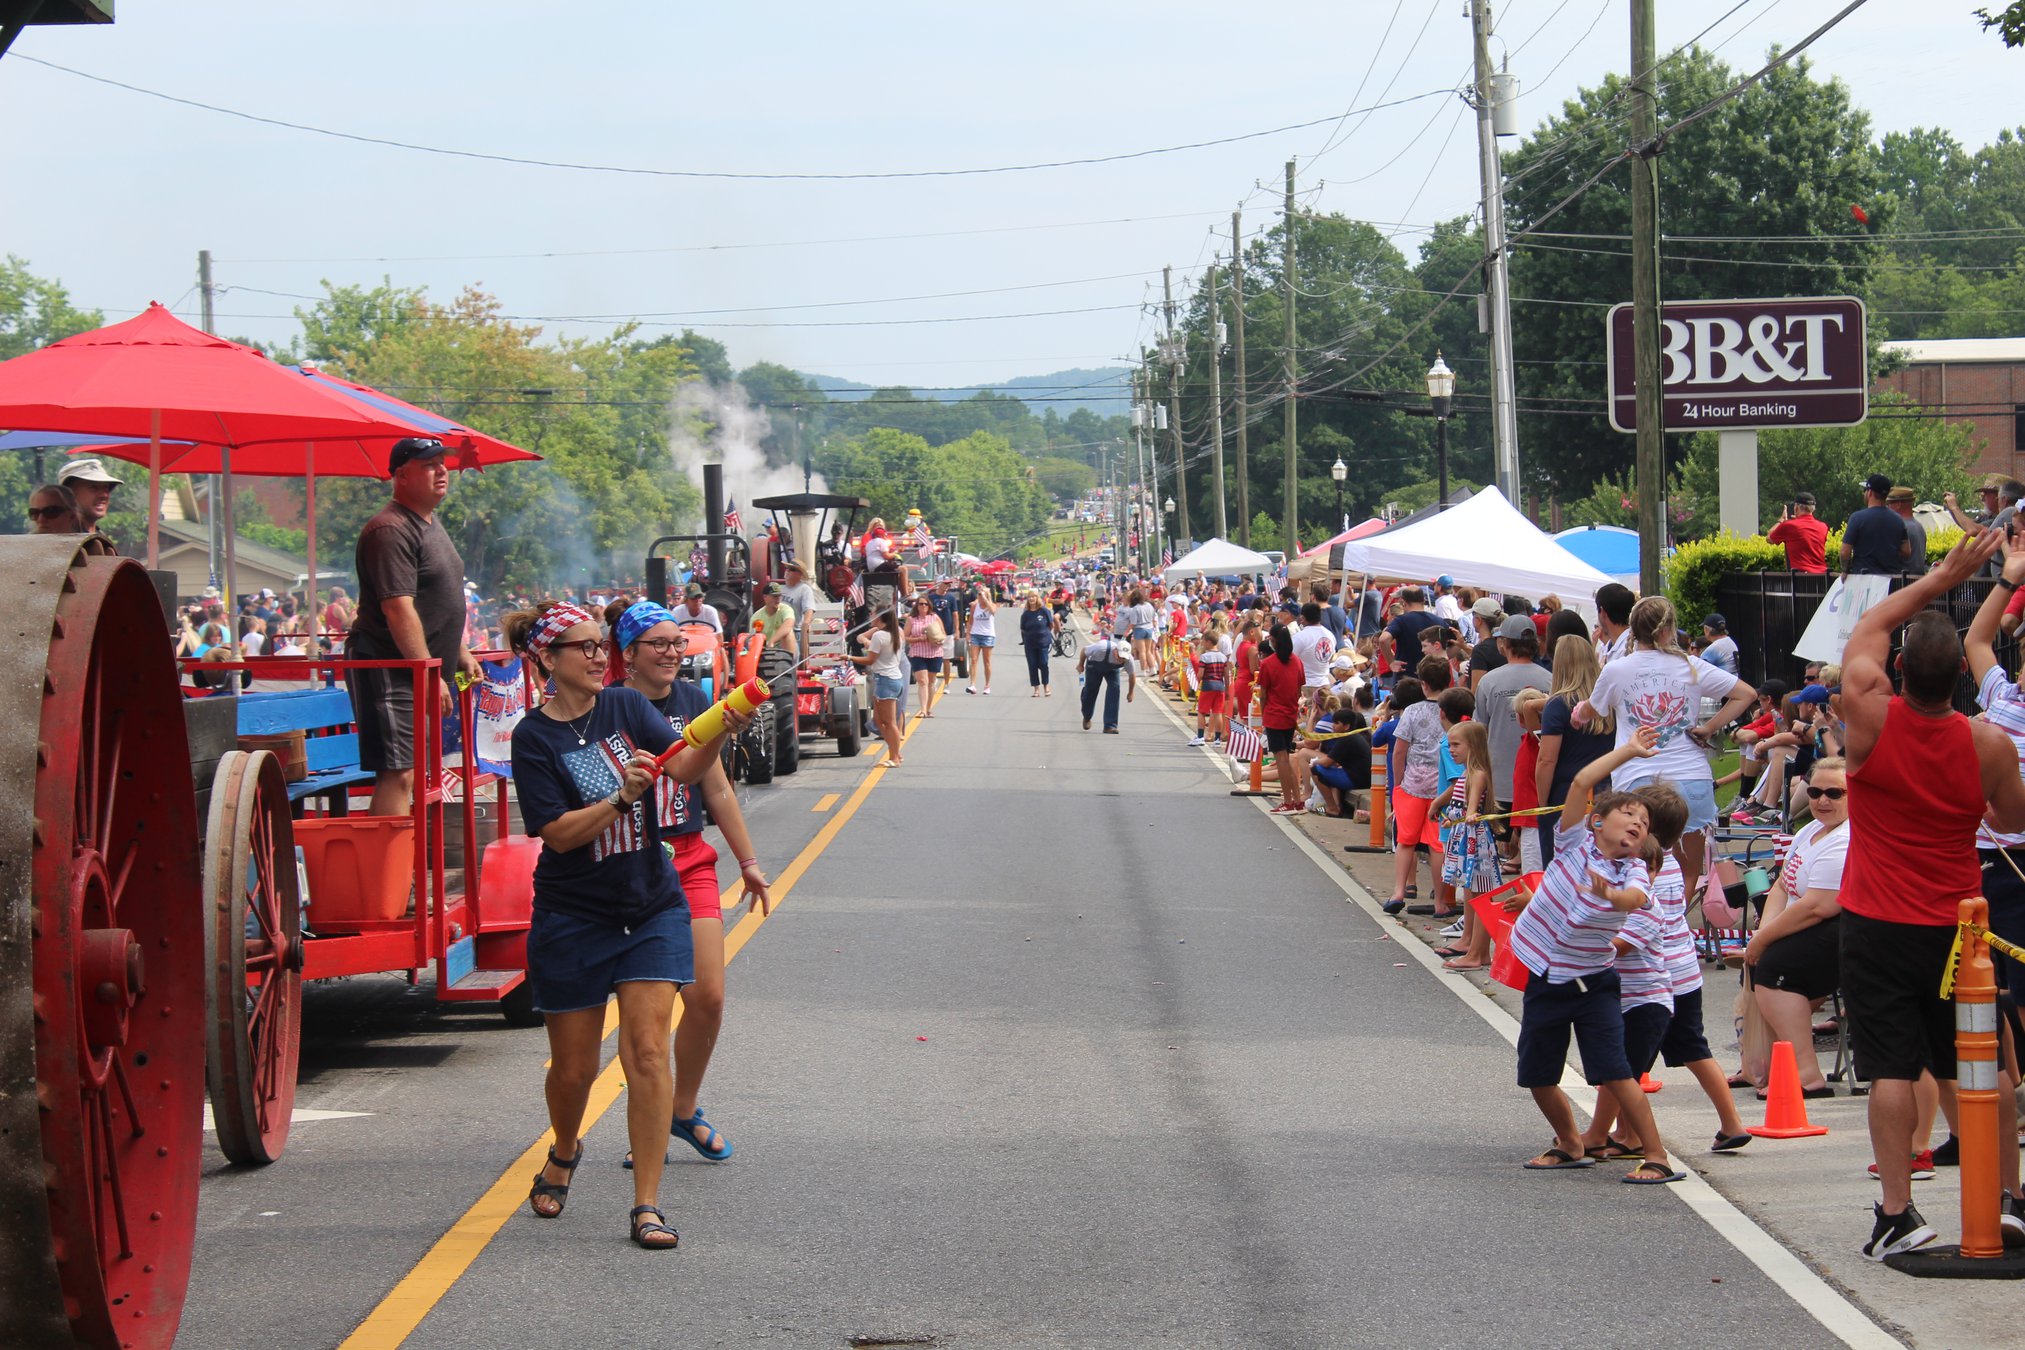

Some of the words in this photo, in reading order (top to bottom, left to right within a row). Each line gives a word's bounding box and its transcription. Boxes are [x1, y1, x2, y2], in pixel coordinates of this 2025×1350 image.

[1633, 314, 1844, 386] BB&T
[1682, 403, 1698, 419] 24
[1701, 404, 1735, 418] Hour
[1740, 403, 1797, 418] Banking
[1623, 677, 1686, 697] AMERICA
[605, 733, 633, 767] RUST
